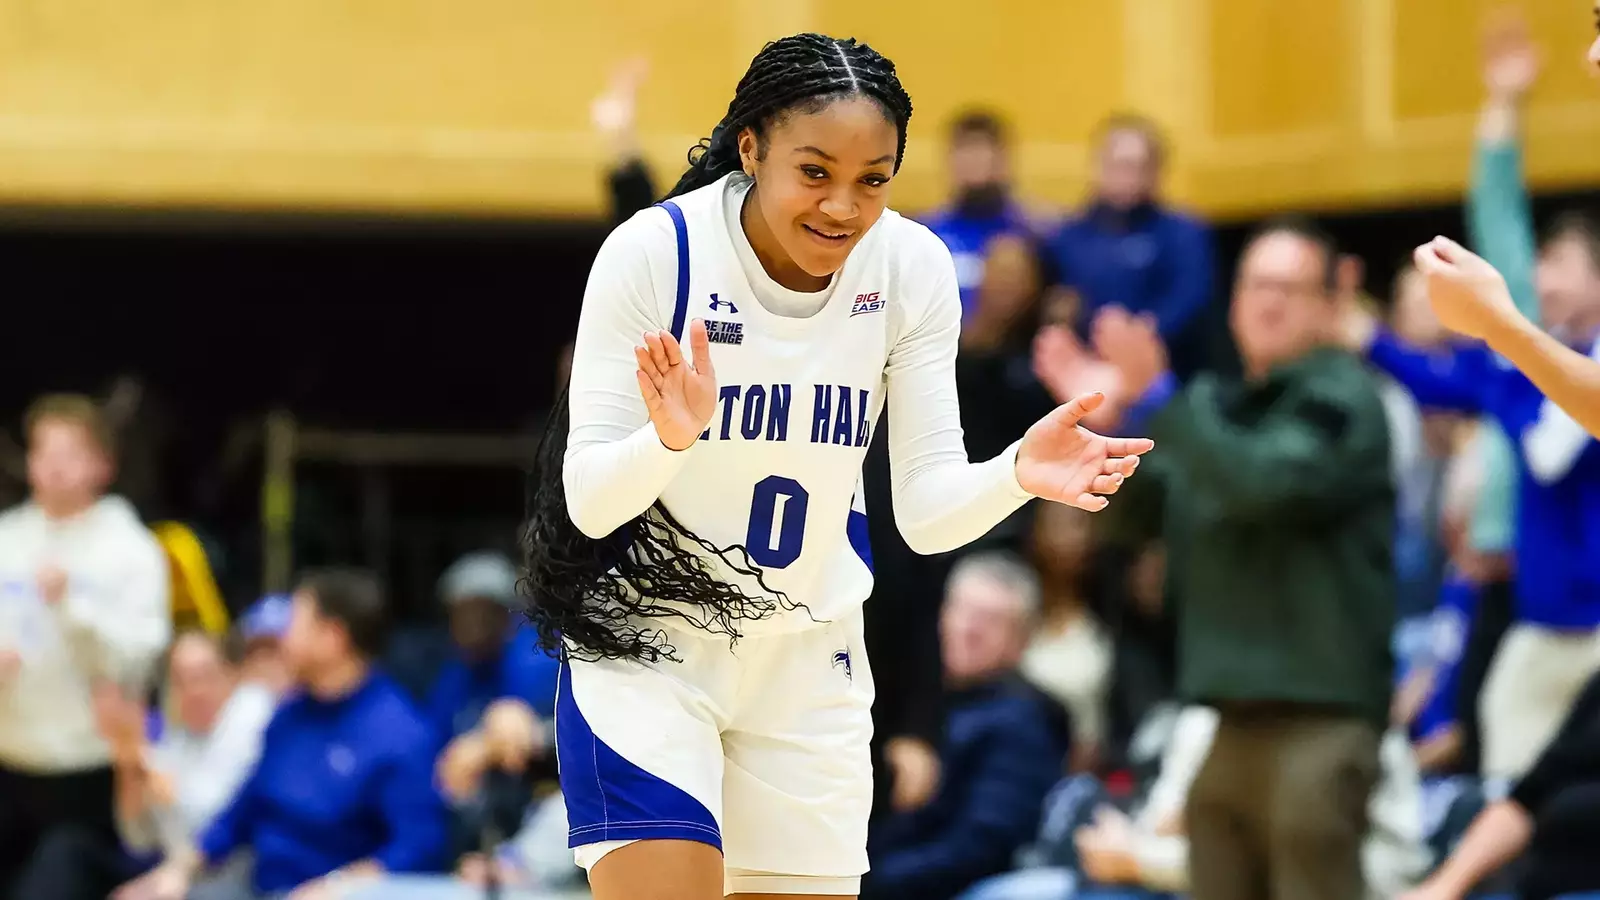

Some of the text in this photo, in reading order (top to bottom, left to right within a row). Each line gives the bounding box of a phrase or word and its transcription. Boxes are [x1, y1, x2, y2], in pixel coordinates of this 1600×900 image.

[855, 291, 880, 304] BIG
[852, 300, 886, 312] EAST
[704, 319, 743, 334] BE THE
[707, 331, 744, 345] HANGE
[699, 384, 791, 441] TON
[746, 475, 809, 569] 0
